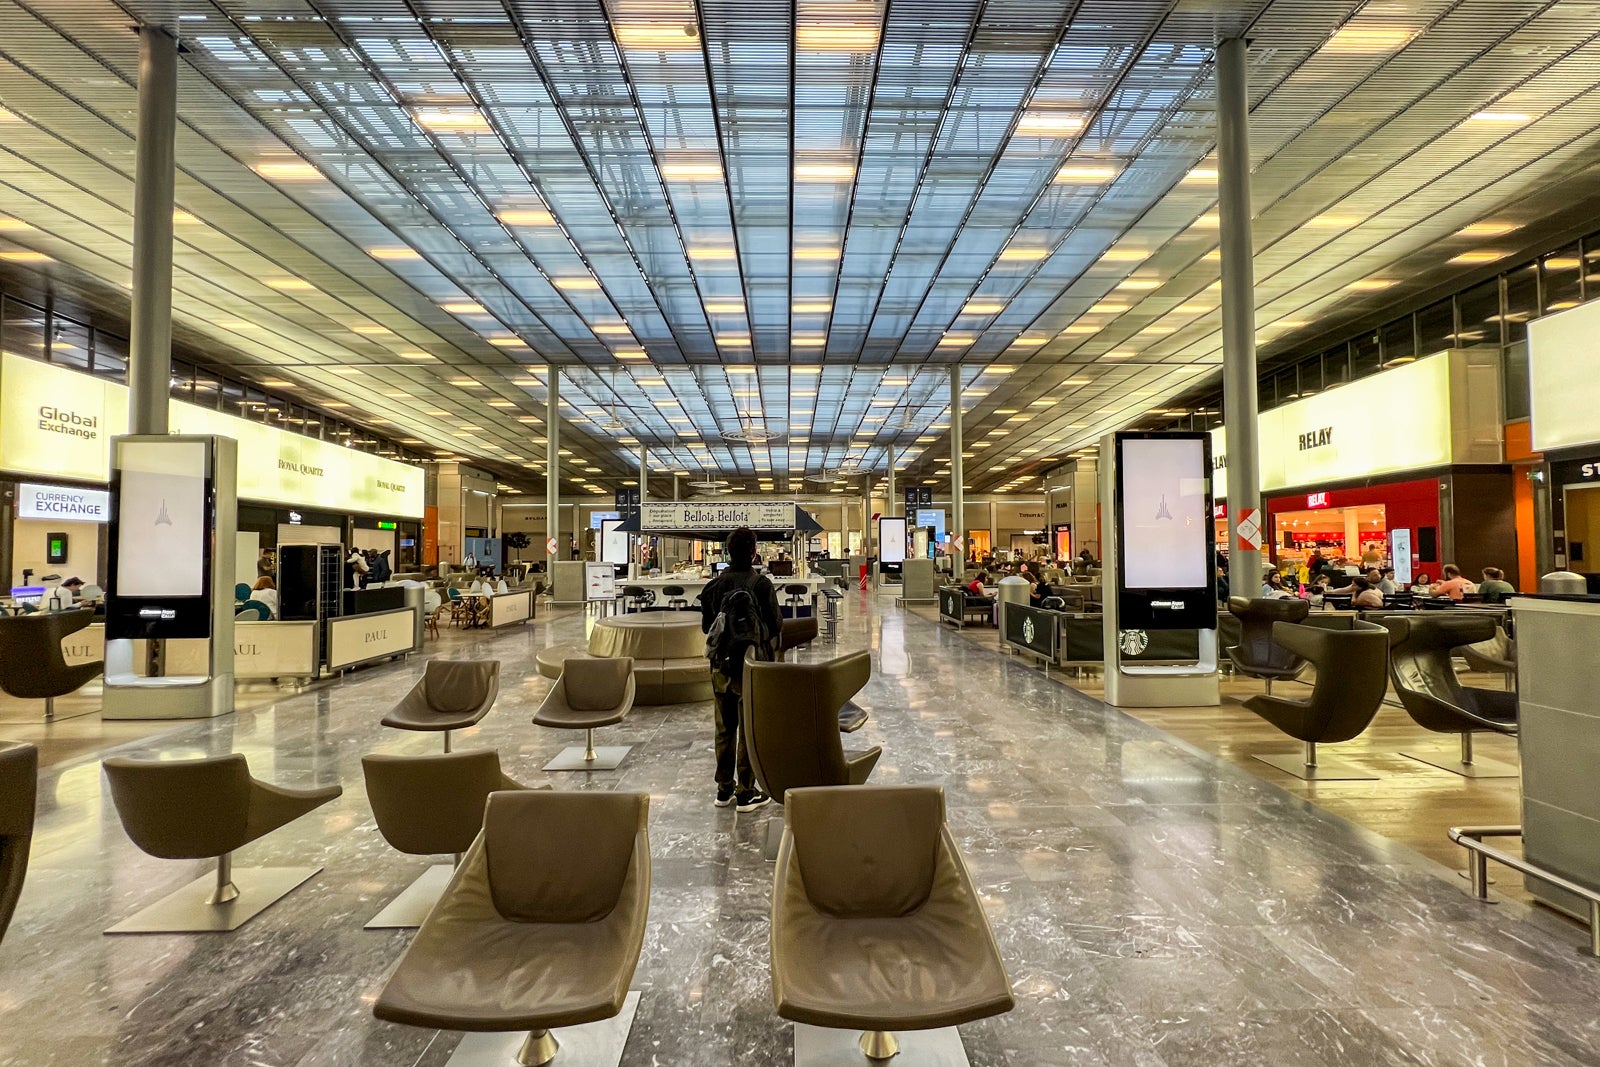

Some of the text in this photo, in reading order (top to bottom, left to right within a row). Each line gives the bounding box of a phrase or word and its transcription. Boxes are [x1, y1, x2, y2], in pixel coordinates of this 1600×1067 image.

[40, 406, 97, 428] Global
[39, 419, 97, 440] Exchange
[1298, 426, 1332, 451] RELAY
[278, 459, 324, 476] ROYAL QUARTZ
[1214, 455, 1227, 469] LAY
[35, 492, 84, 503] CURRENCY
[1308, 492, 1325, 506] RELAY
[36, 501, 101, 515] EXCHANGE
[684, 509, 748, 522] Bellota-Bellota
[365, 629, 388, 643] PAUL
[64, 645, 94, 657] AUL
[234, 644, 261, 656] UL
